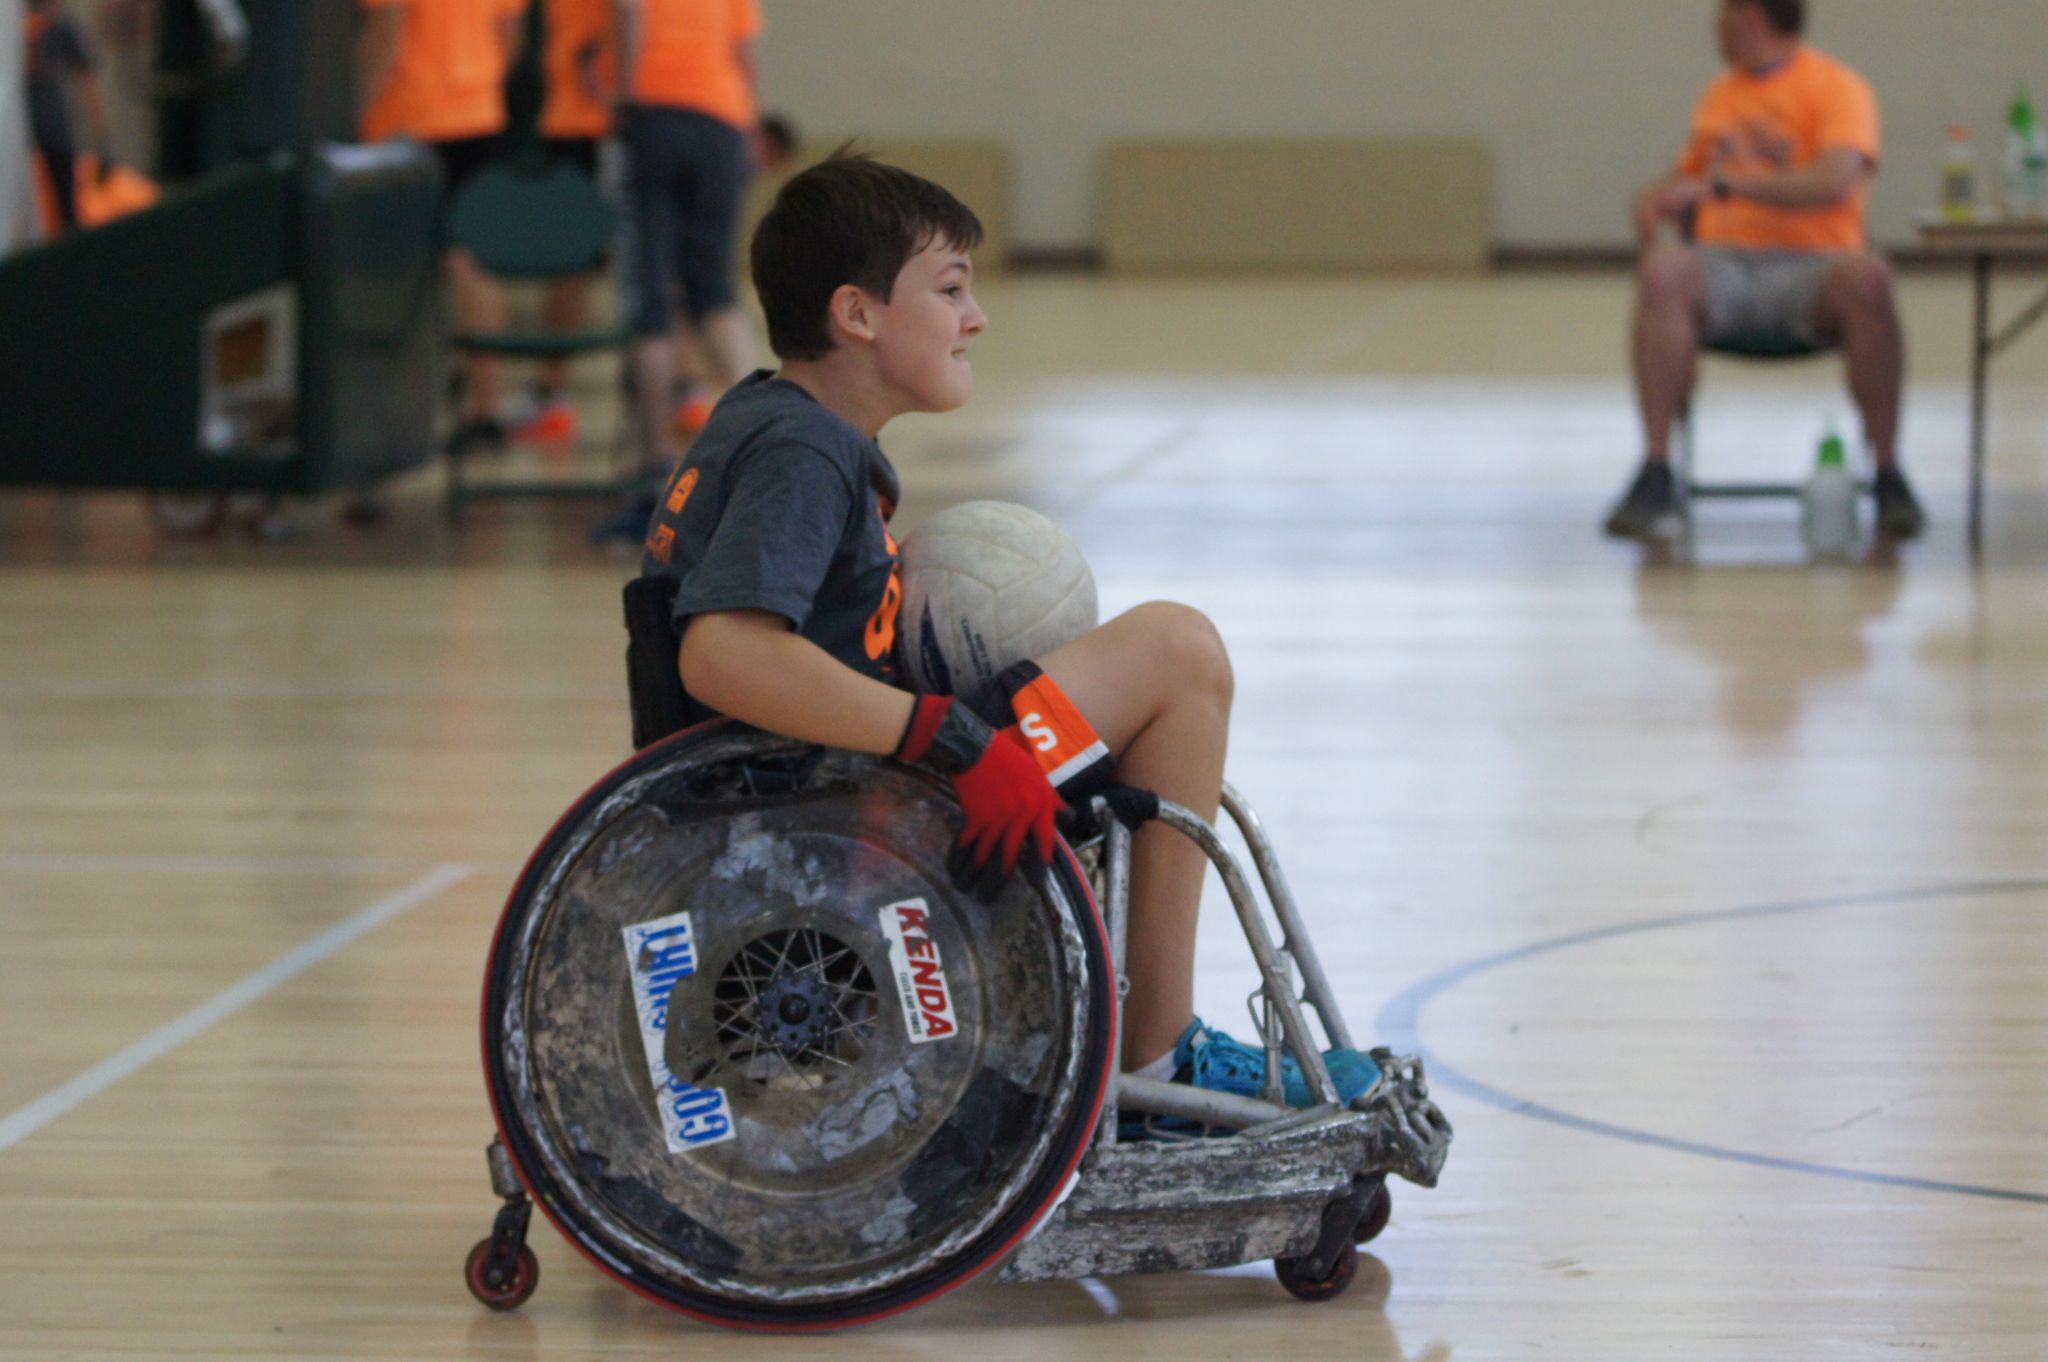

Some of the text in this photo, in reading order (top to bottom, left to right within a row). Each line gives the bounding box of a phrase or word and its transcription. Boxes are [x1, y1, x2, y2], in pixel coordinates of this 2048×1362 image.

[1020, 713, 1057, 751] S
[896, 907, 953, 1038] KENDA
[667, 1075, 730, 1143] CO
